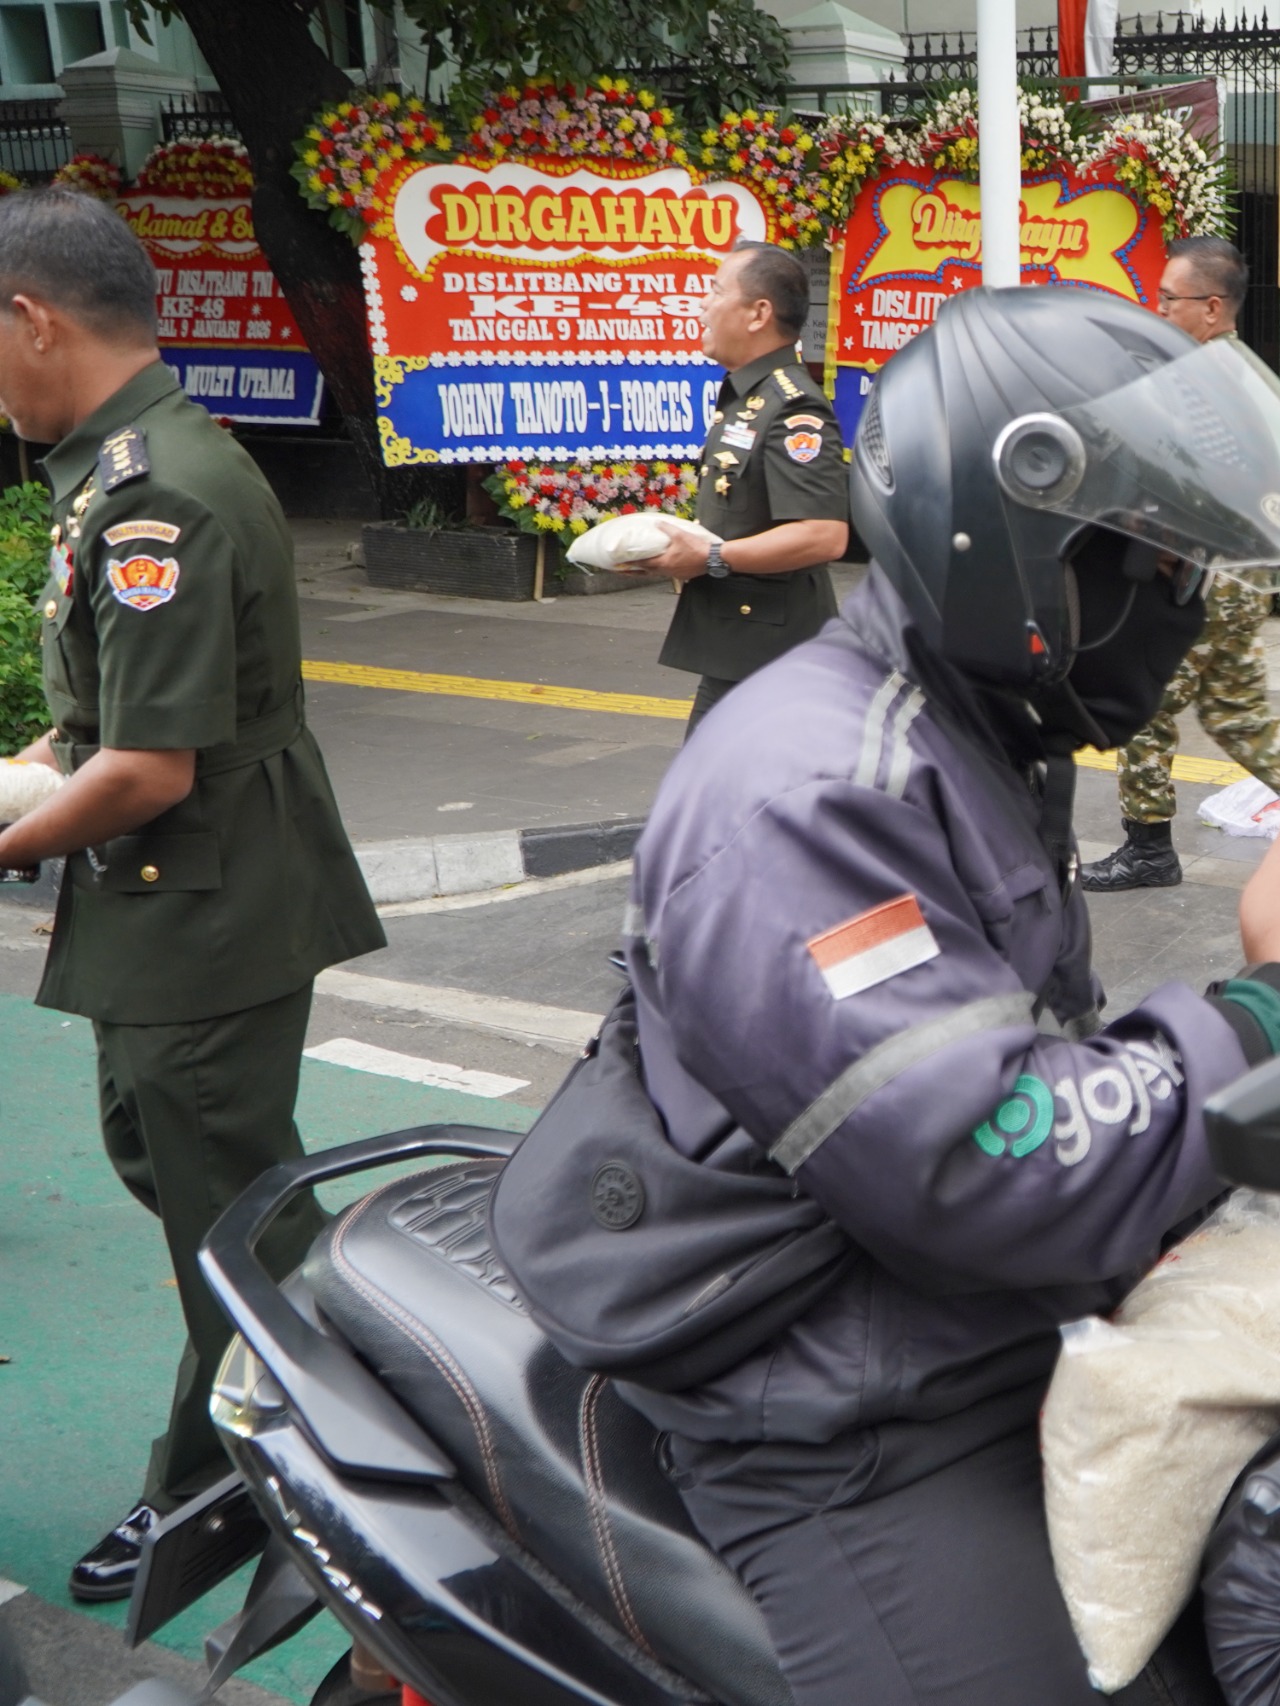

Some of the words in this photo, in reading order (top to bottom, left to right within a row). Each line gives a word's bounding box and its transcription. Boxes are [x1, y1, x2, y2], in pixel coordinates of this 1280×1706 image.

[210, 210, 228, 238] &
[441, 193, 732, 245] DIRGAHAYU
[177, 270, 248, 296] DISLITBANG
[252, 271, 273, 297] TNI
[443, 272, 622, 294] DISLITBANG
[629, 273, 676, 293] TNI
[161, 296, 225, 319] KE-48
[468, 294, 703, 318] KE-48
[180, 319, 189, 338] 9
[192, 320, 240, 338] JANUARI
[448, 319, 552, 342] TANGGAL
[558, 319, 570, 341] 9
[576, 319, 666, 341] JANUARI
[184, 364, 236, 397] MULTI
[239, 366, 295, 400] UTAMA
[437, 382, 504, 438] JOHNY
